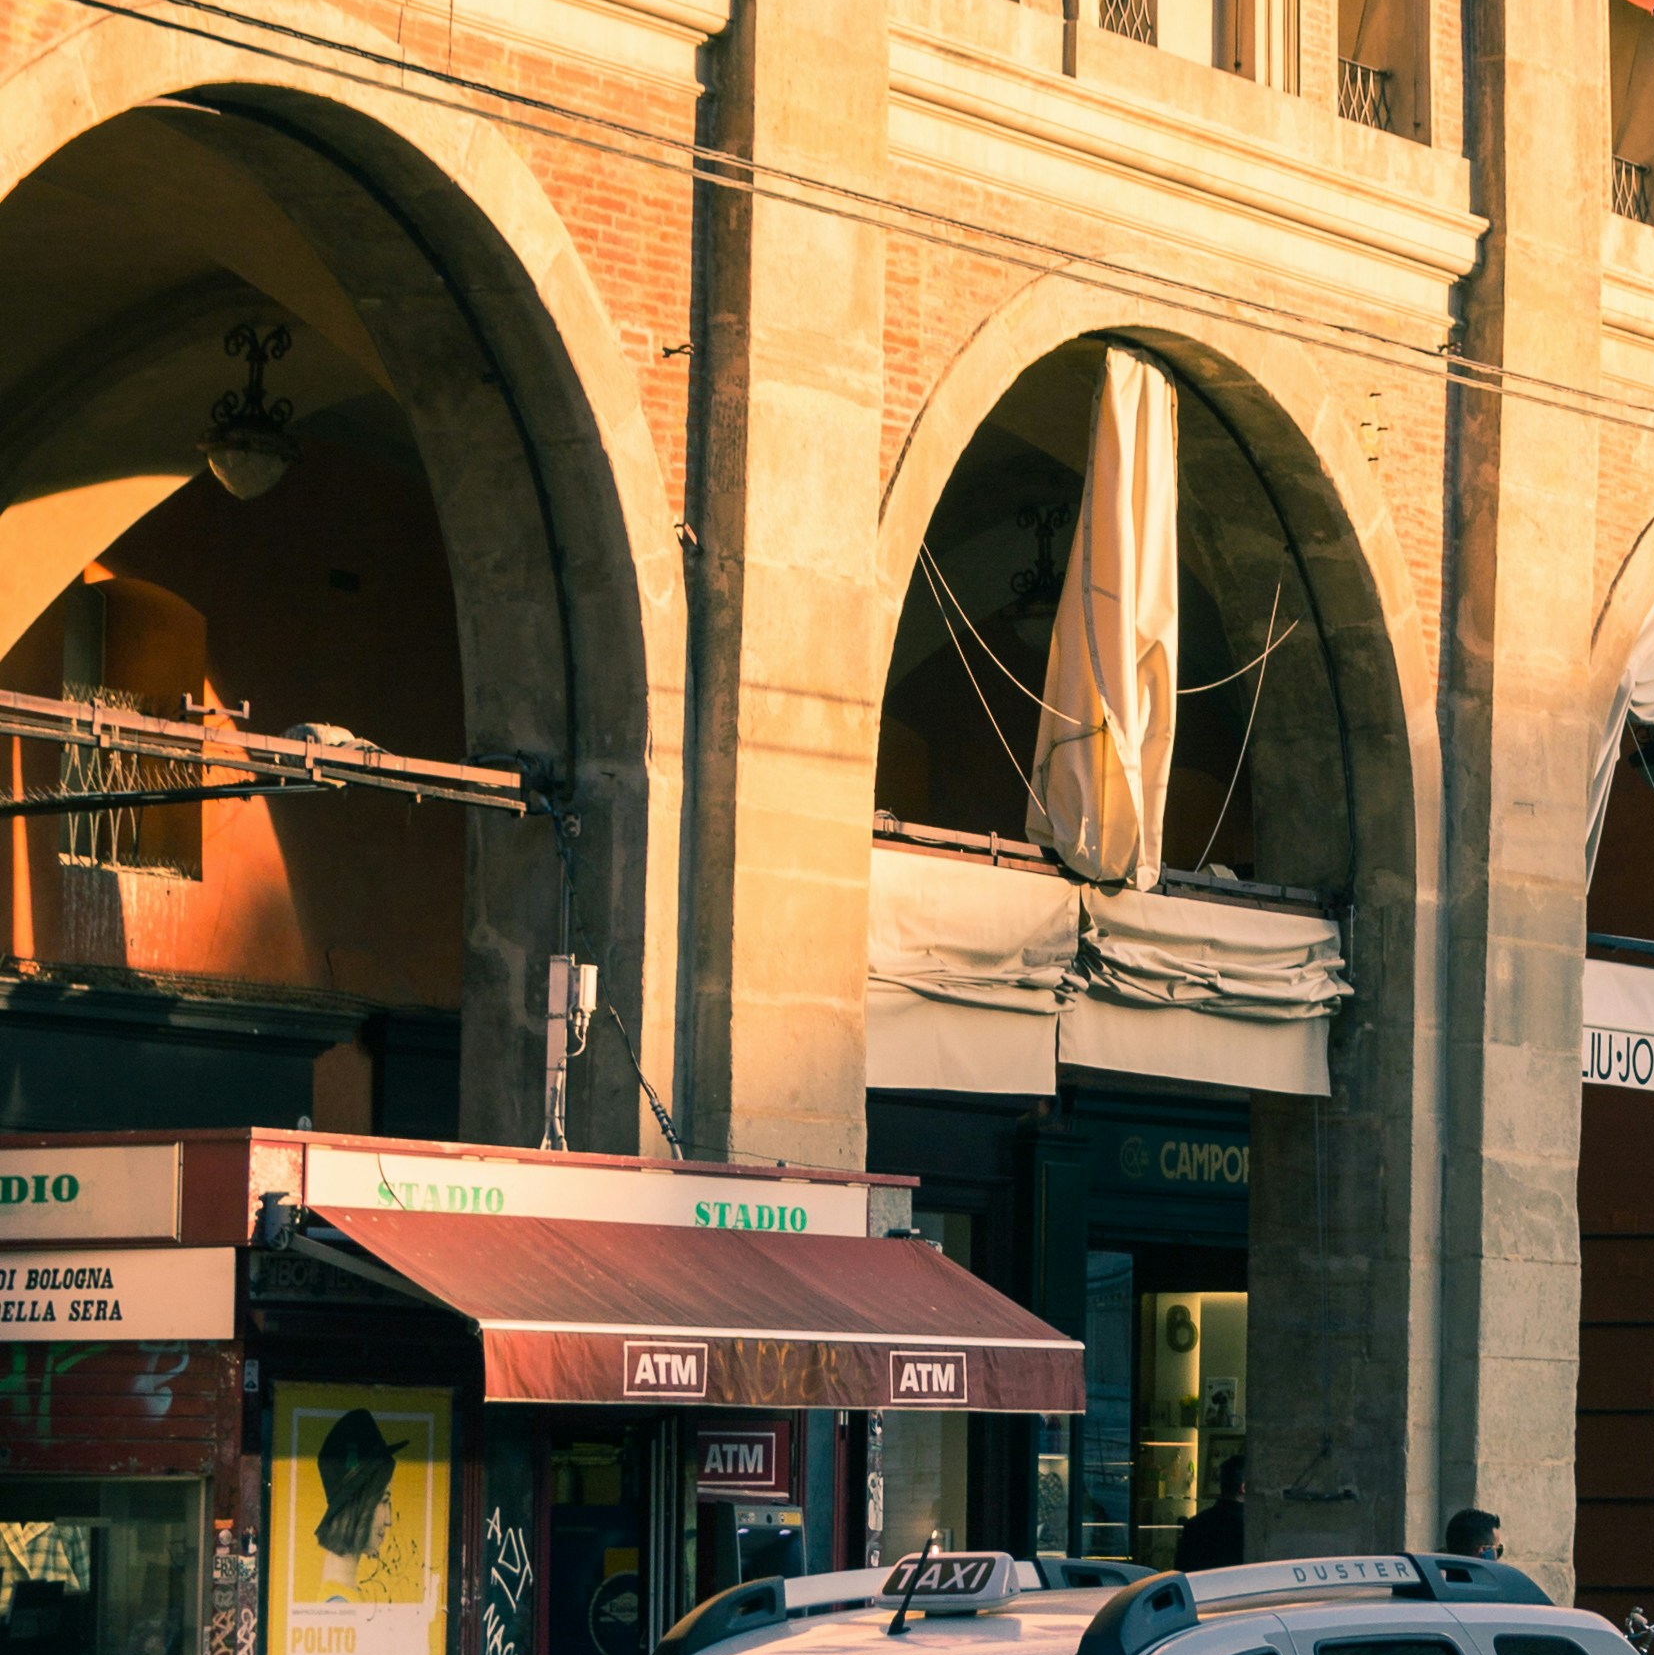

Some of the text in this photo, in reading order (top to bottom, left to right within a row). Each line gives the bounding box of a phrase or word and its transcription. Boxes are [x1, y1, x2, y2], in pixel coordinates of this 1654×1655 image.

[377, 1179, 505, 1214] STADIO
[695, 1200, 808, 1232] STADIO
[25, 1267, 114, 1291] BOLOGNA
[0, 1299, 123, 1323] ELLA SERA
[633, 1353, 697, 1386] ATM
[899, 1363, 956, 1393] ATM
[704, 1443, 764, 1474] ATM
[896, 1561, 990, 1591] TAXI
[1292, 1562, 1410, 1583] DUSTER
[291, 1626, 357, 1654] POLITO
